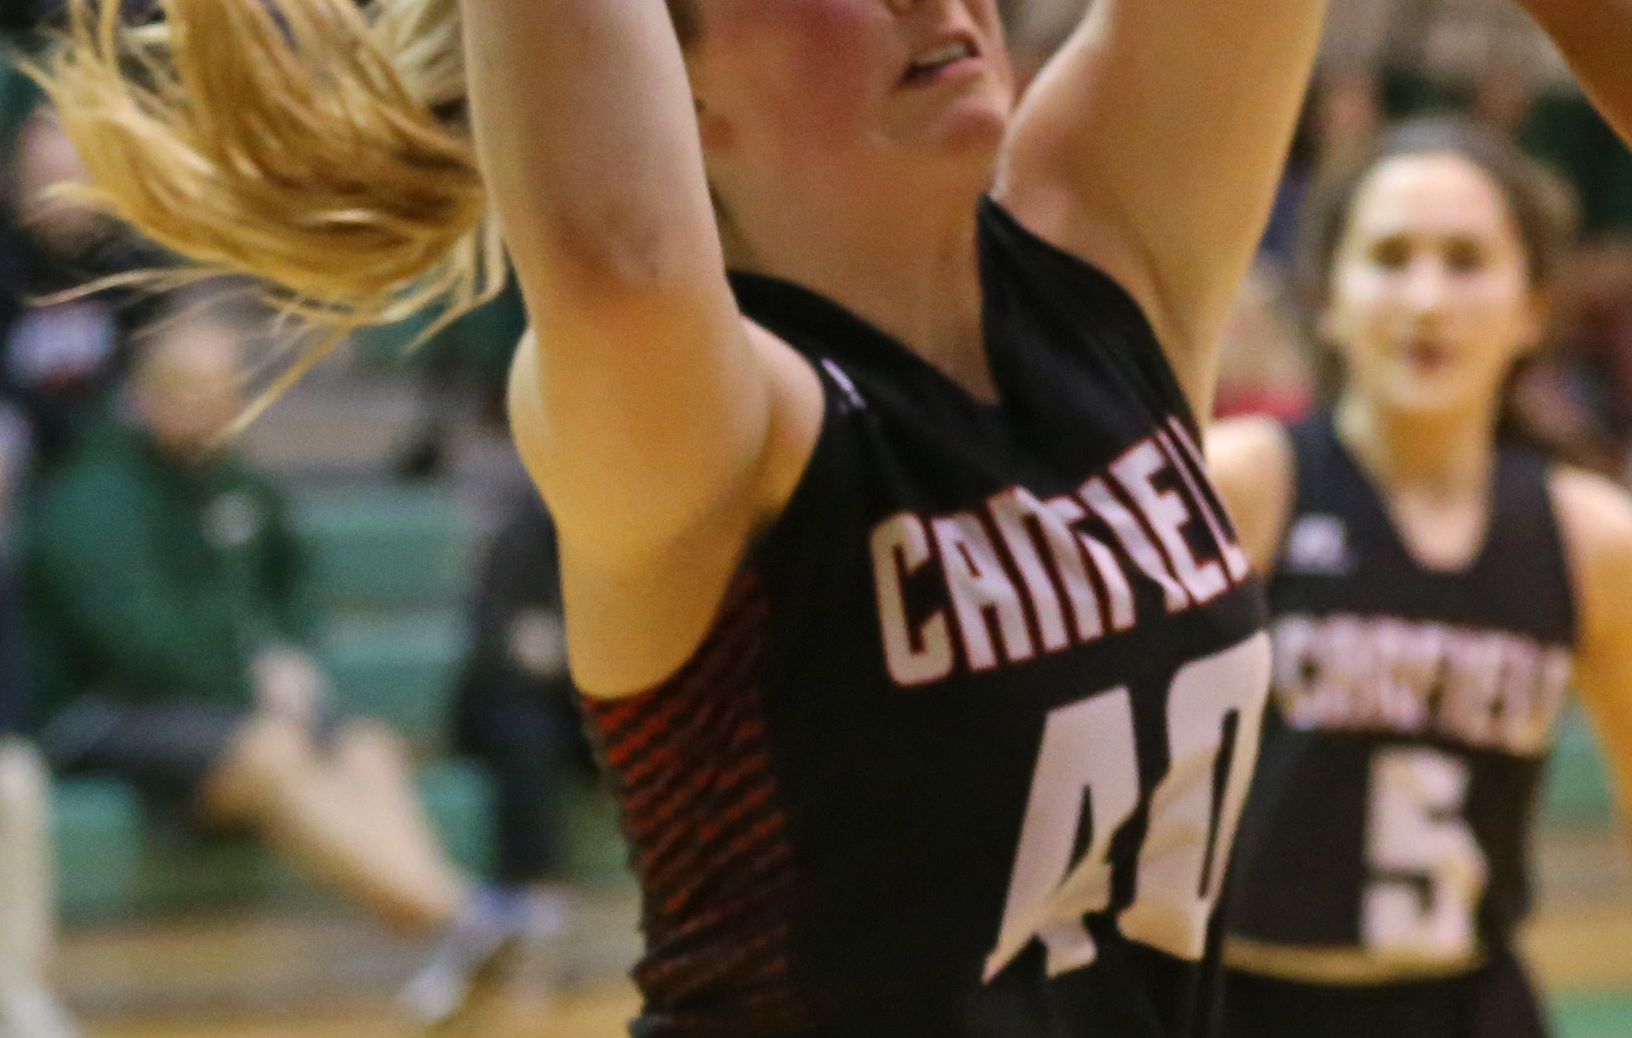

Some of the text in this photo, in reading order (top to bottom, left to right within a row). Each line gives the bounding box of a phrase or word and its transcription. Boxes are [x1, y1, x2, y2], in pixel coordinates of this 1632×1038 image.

[868, 413, 1250, 688] CANFIEL
[979, 629, 1273, 986] 40
[1362, 745, 1487, 958] 5
